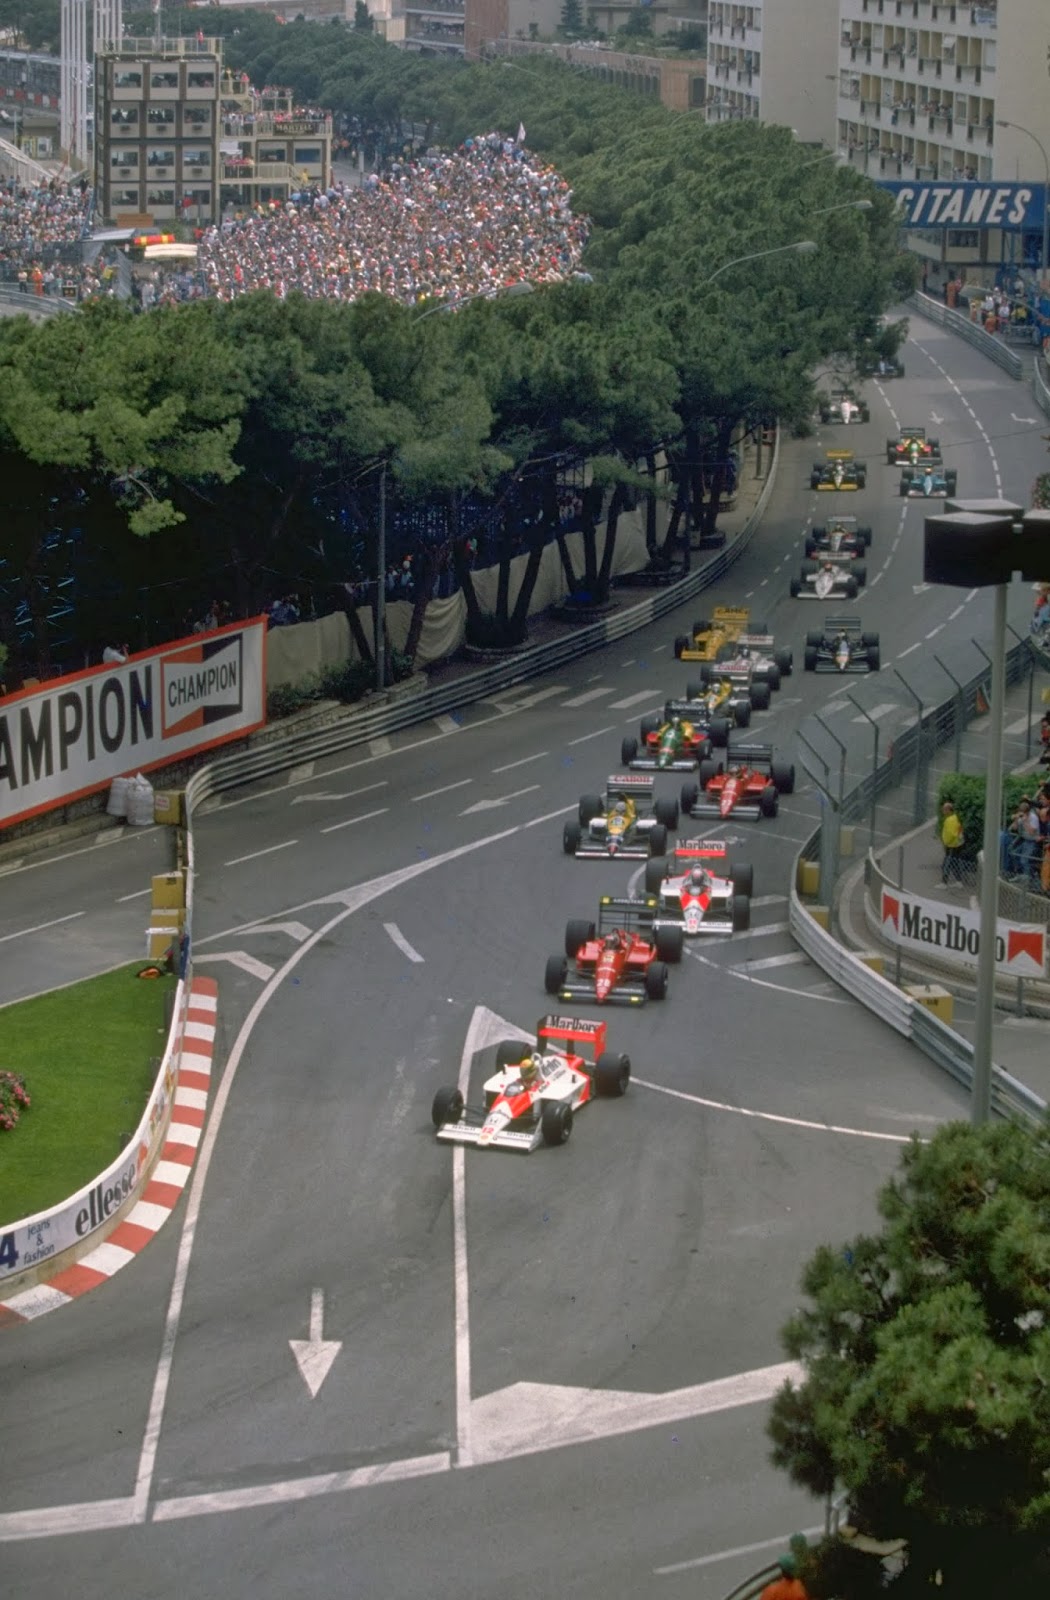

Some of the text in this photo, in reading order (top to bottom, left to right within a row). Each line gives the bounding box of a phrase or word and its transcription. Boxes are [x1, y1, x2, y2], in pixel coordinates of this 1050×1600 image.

[168, 660, 237, 707] CHAMPION
[679, 839, 723, 850] Marlboro
[901, 902, 1006, 962] Marlboo
[482, 1127, 495, 1135] 12
[75, 1163, 136, 1237] ellesse
[28, 1220, 51, 1240] jeans
[24, 1243, 55, 1266] fashion
